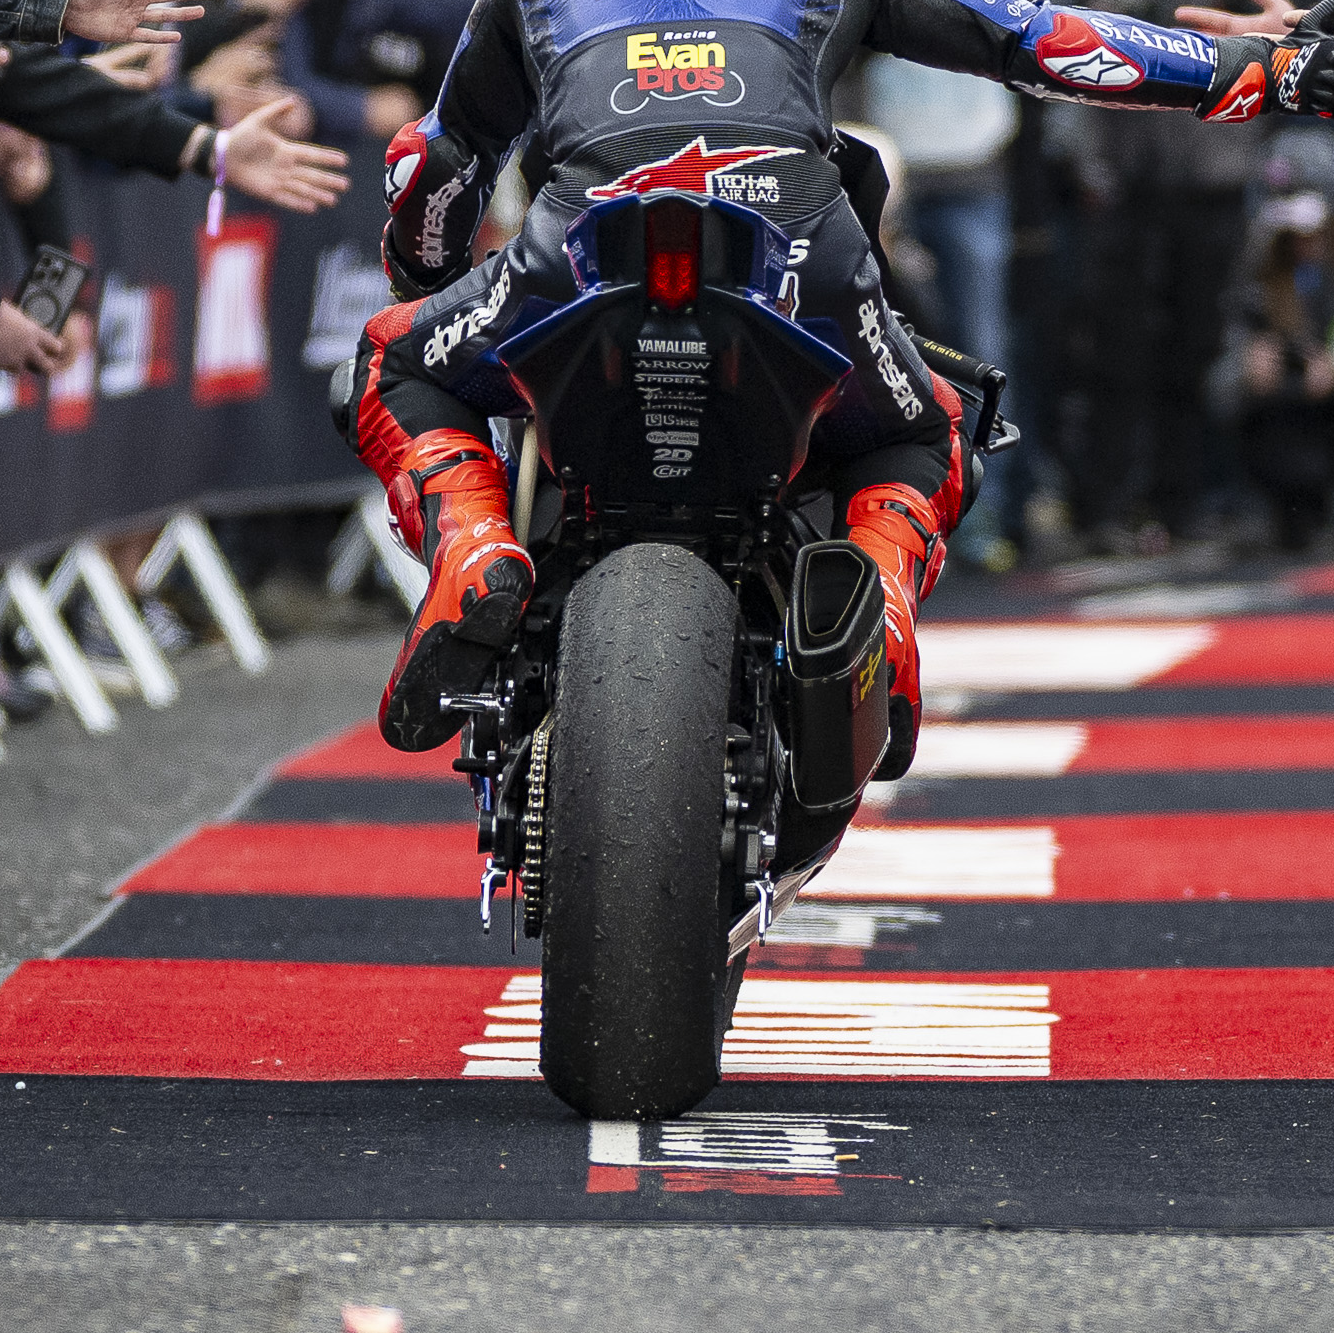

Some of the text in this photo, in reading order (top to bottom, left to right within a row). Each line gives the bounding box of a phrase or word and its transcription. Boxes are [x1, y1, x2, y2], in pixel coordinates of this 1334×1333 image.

[663, 30, 717, 42] Racing
[1089, 17, 1124, 42] Si
[626, 32, 726, 70] Evan
[637, 58, 725, 92] Bros
[718, 188, 780, 203] AIR BAG
[423, 261, 511, 366] alpinestars
[637, 339, 707, 355] YAMALUBE
[634, 359, 710, 370] ARROW
[858, 299, 923, 420] alpinestars
[653, 448, 693, 462] 2D
